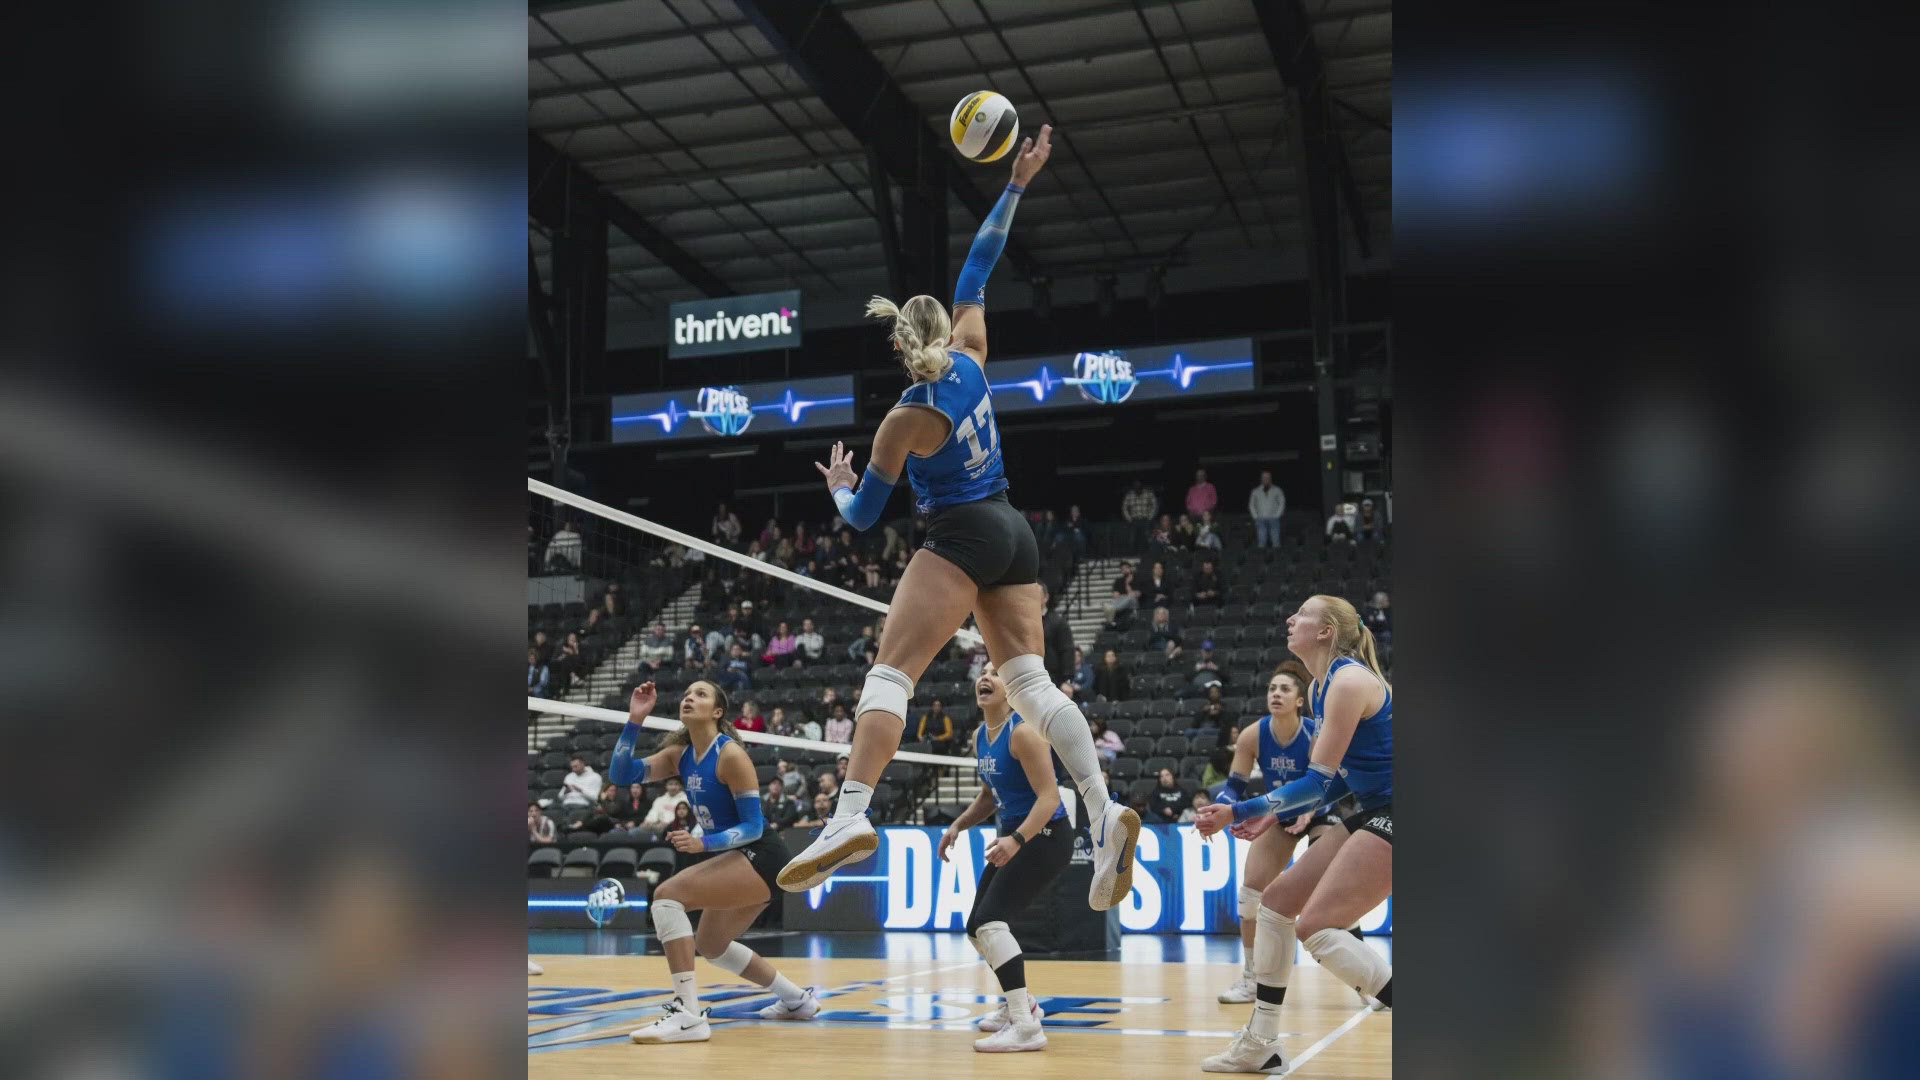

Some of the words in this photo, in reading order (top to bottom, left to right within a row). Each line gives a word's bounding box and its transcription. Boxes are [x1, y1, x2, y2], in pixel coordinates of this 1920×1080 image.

[675, 308, 796, 345] thrivent
[1084, 353, 1133, 382] PULSE
[705, 388, 750, 415] PULSE
[956, 391, 998, 471] 17
[979, 759, 996, 772] PULSE
[1271, 757, 1296, 769] PULSE
[1366, 816, 1392, 833] PULS
